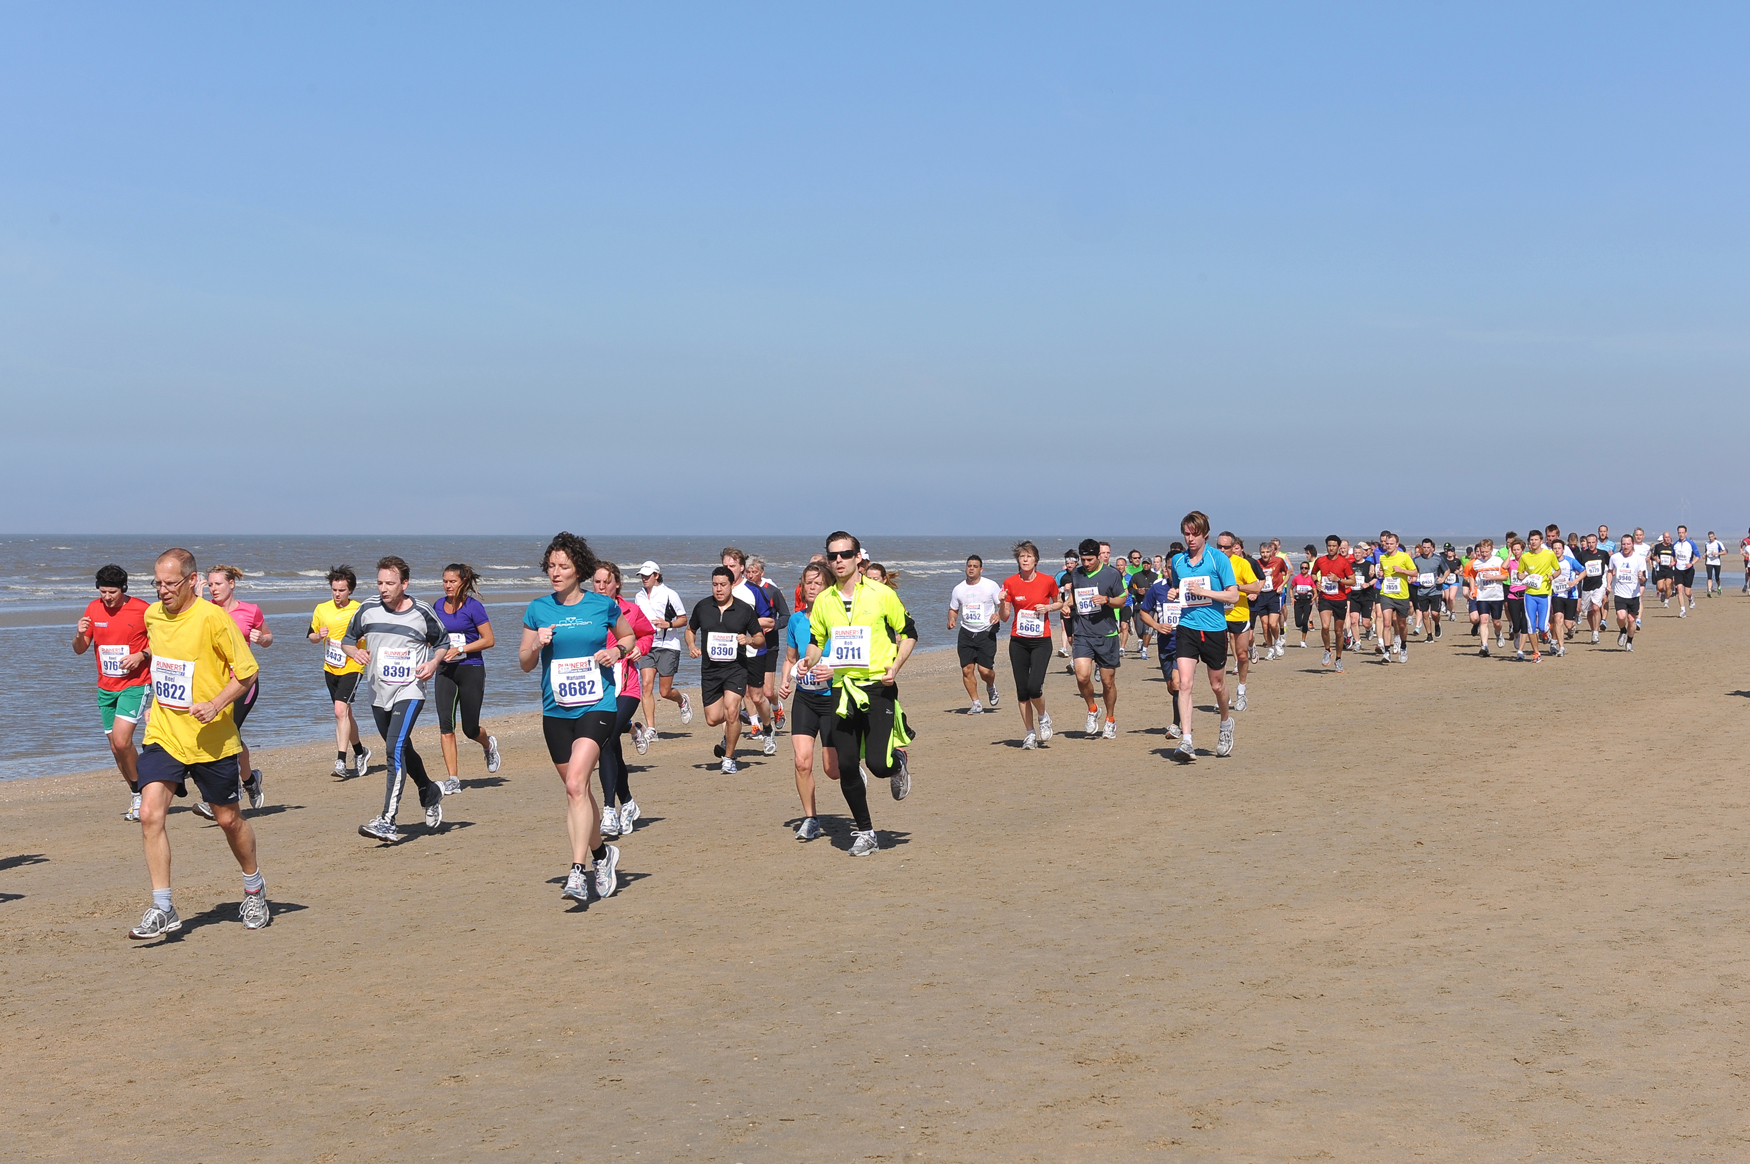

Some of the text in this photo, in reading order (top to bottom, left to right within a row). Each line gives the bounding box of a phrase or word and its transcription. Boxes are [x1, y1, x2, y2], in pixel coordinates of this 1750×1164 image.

[1079, 600, 1097, 610] 964
[710, 646, 734, 656] 8390
[836, 646, 861, 660] 9711
[103, 660, 124, 671] 976
[382, 665, 411, 678] 8391
[155, 680, 186, 701] 6822
[558, 680, 597, 698] 8682
